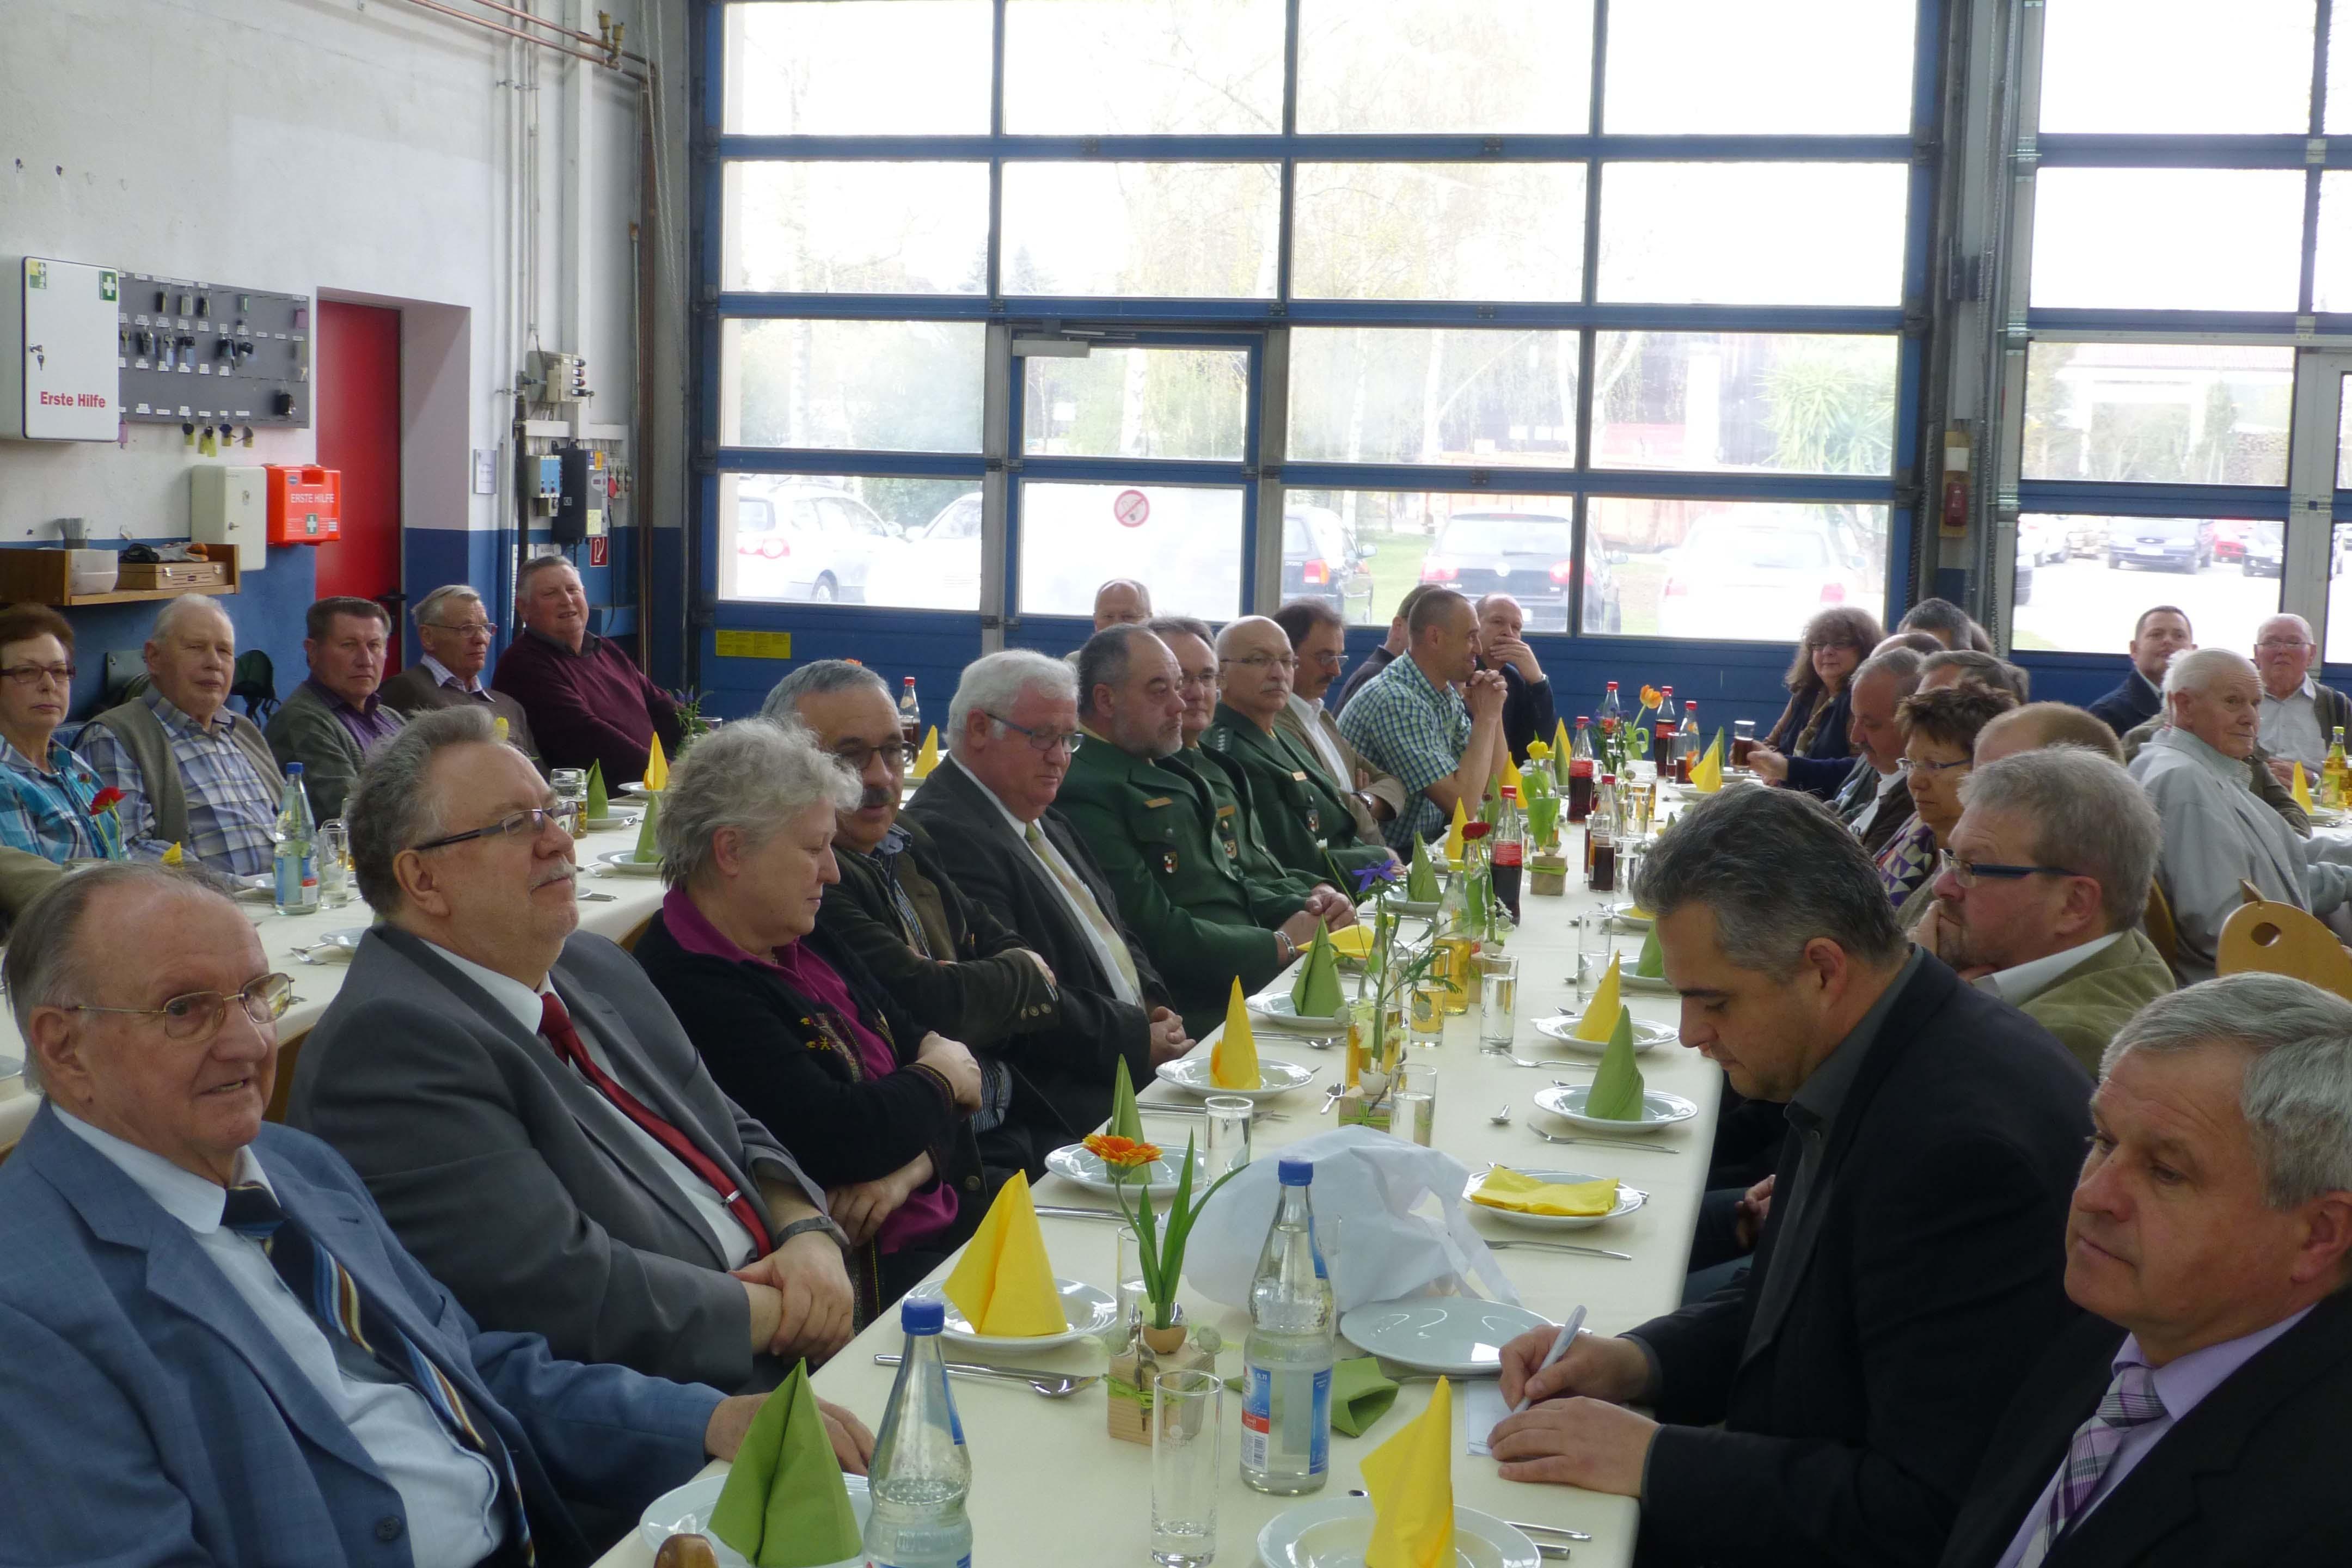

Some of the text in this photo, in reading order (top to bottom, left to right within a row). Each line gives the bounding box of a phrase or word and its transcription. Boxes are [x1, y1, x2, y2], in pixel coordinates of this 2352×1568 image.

[40, 391, 106, 408] Erste Hilfe
[291, 493, 334, 503] ERSTE HILFE
